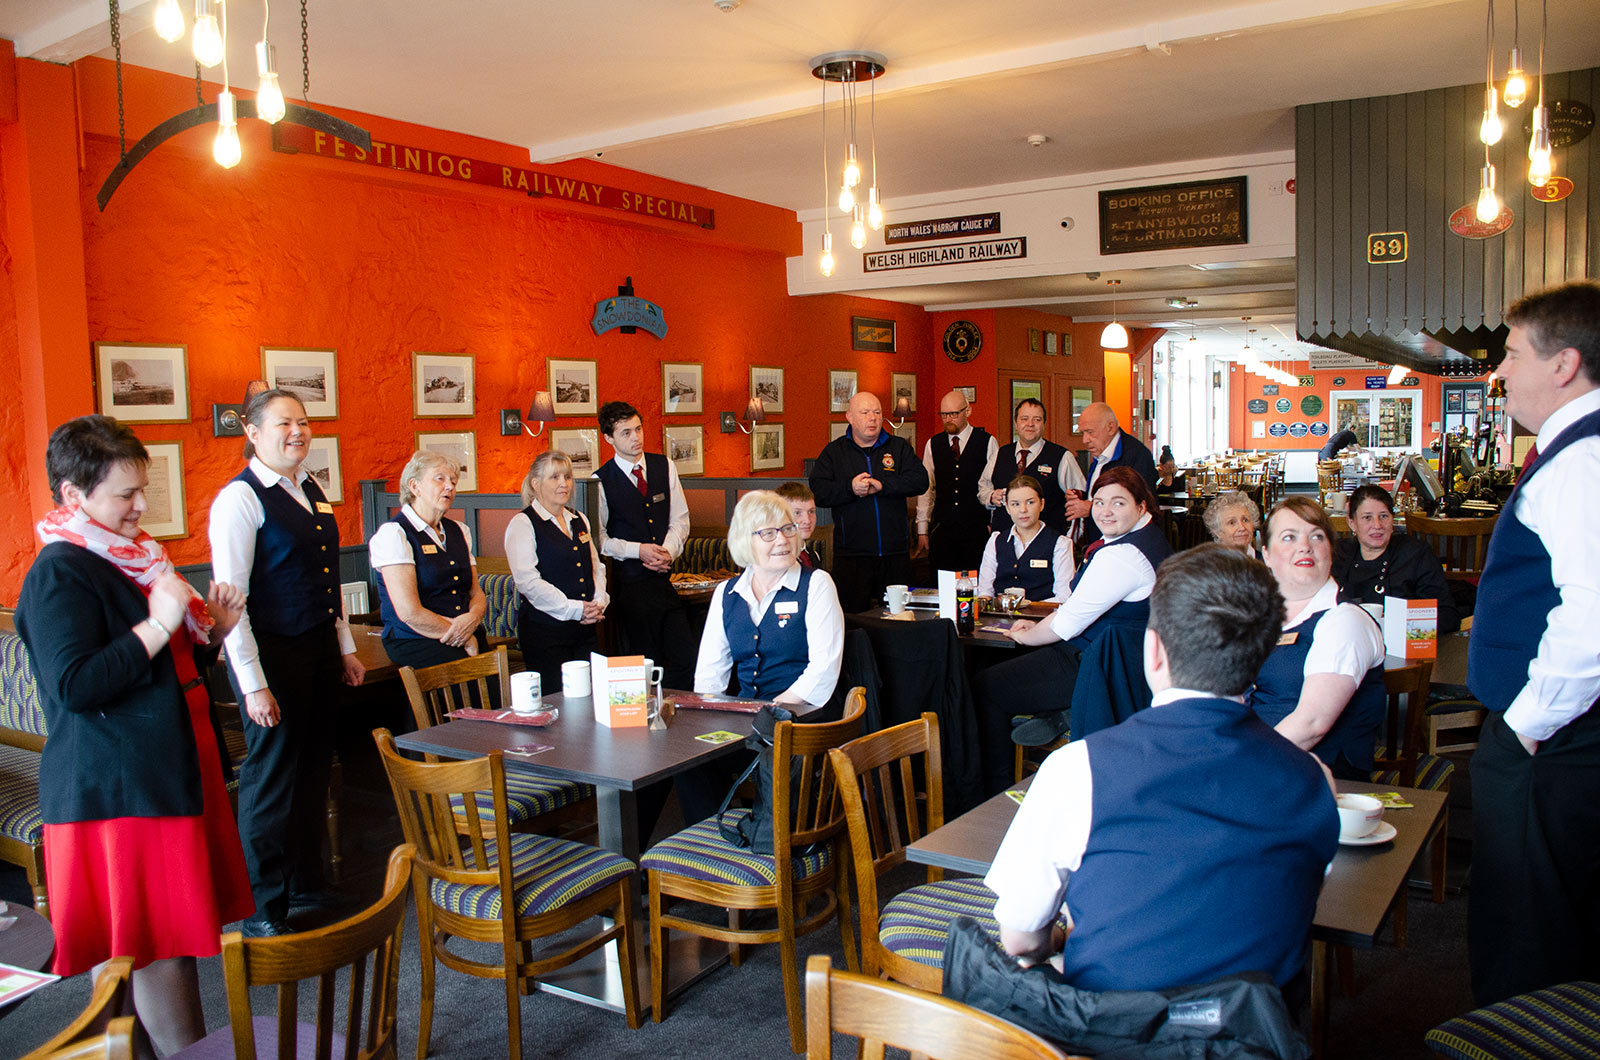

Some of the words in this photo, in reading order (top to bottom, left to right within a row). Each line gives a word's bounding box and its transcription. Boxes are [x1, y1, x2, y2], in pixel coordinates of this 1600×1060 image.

[314, 131, 472, 179] FESTINIOG
[502, 166, 603, 204] RAILWAY
[622, 191, 697, 223] SPECIAL
[1108, 194, 1171, 210] BOOKING
[1177, 188, 1234, 203] OFFICE
[1545, 180, 1559, 198] 5
[888, 227, 909, 239] NORTH
[910, 224, 931, 236] WALES
[932, 221, 959, 234] NARROW
[960, 218, 983, 231] GAUGE
[1124, 212, 1221, 230] TANYBWLCH
[868, 253, 904, 268] WELSH
[909, 247, 964, 264] HIGHLAND
[969, 241, 1019, 259] RAILWAY
[1371, 239, 1402, 256] 89
[620, 298, 640, 310] THE
[596, 310, 666, 335] SNOWDONIAN
